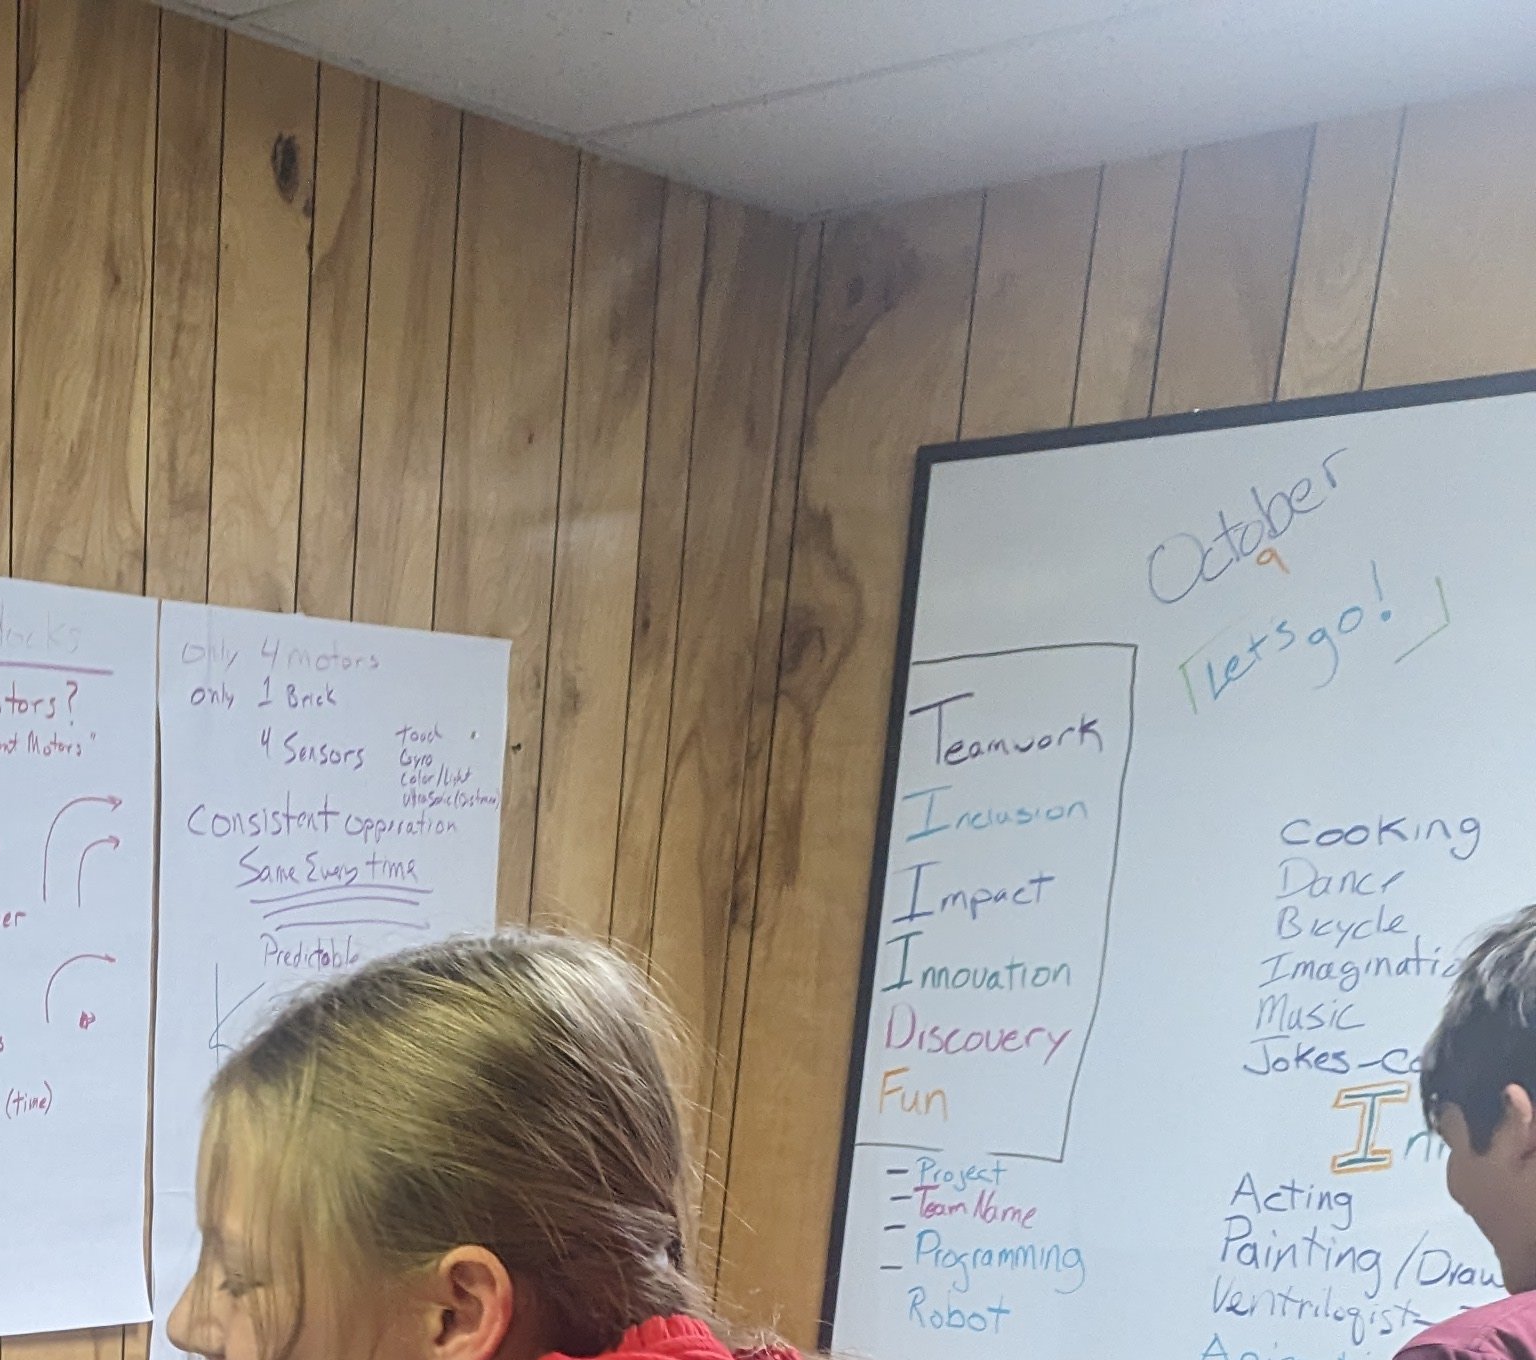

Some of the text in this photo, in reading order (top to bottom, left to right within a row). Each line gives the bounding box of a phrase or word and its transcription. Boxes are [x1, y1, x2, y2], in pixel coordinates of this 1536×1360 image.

[1148, 447, 1349, 604] October
[260, 637, 280, 667] 4
[257, 675, 273, 708] 1
[286, 682, 338, 709] Brick
[260, 726, 365, 771] 4 Sensors
[909, 692, 1103, 766] Teamwork
[187, 790, 341, 838] Consistent
[903, 785, 1088, 843] Inclusion
[1280, 814, 1482, 860] Cooking
[235, 845, 418, 888] Same Every time
[1275, 857, 1406, 900] Dance
[892, 859, 1056, 925] Impact
[1275, 904, 1409, 949] Bicycle
[260, 933, 360, 971] Predictable
[880, 931, 1072, 993] Innovation
[884, 1002, 1073, 1066] Discovery
[1255, 993, 1366, 1032] Music
[5, 1080, 54, 1120] (time)
[878, 1066, 949, 1122] Fun
[916, 1156, 1008, 1192] Project
[913, 1184, 1037, 1230] Team Name
[1230, 1172, 1354, 1231] Acting
[915, 1229, 1086, 1295] Programming
[908, 1286, 1011, 1333] Robot
